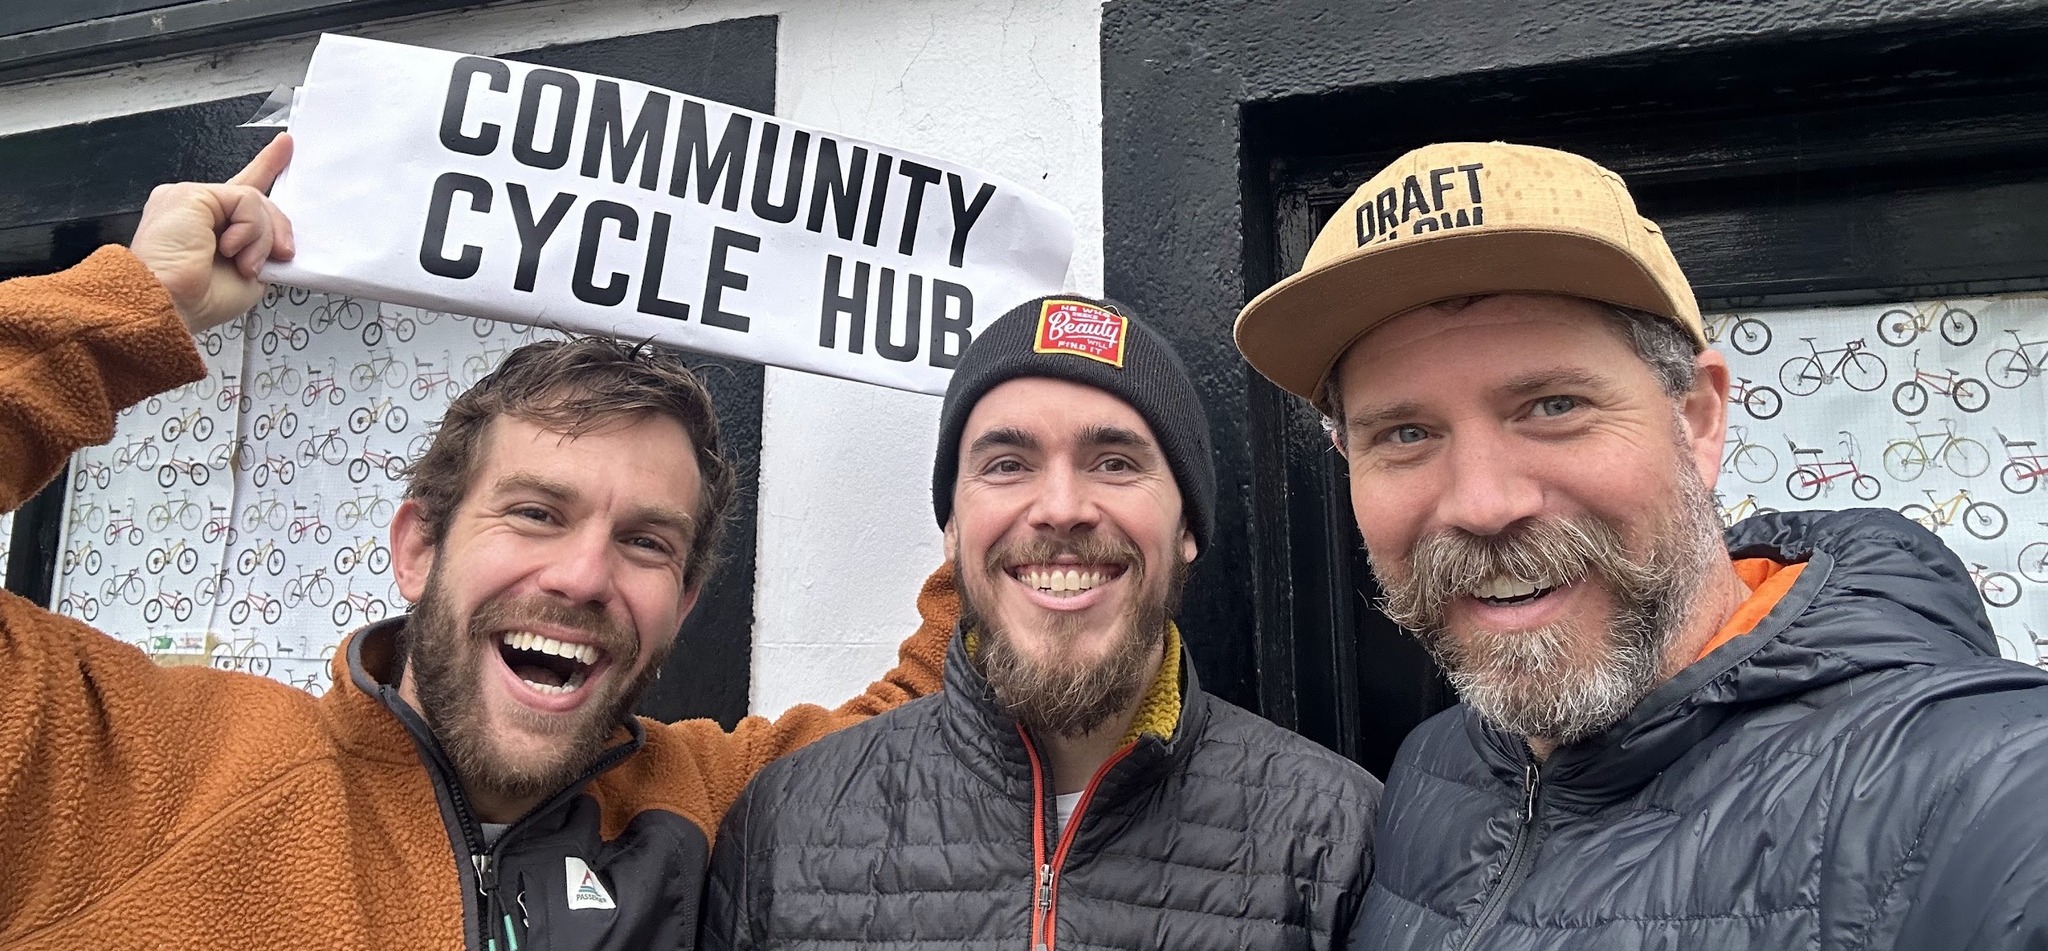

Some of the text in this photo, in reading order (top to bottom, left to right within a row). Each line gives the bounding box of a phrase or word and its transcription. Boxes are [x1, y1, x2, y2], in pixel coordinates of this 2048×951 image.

[439, 56, 996, 267] COMMUNITY
[1356, 163, 1483, 248] DRAFT
[419, 172, 973, 369] CYCLE HUB
[1048, 311, 1119, 348] Beauty
[1082, 307, 1110, 318] WHO
[1058, 341, 1102, 355] FIND IT
[1087, 339, 1108, 349] WILL
